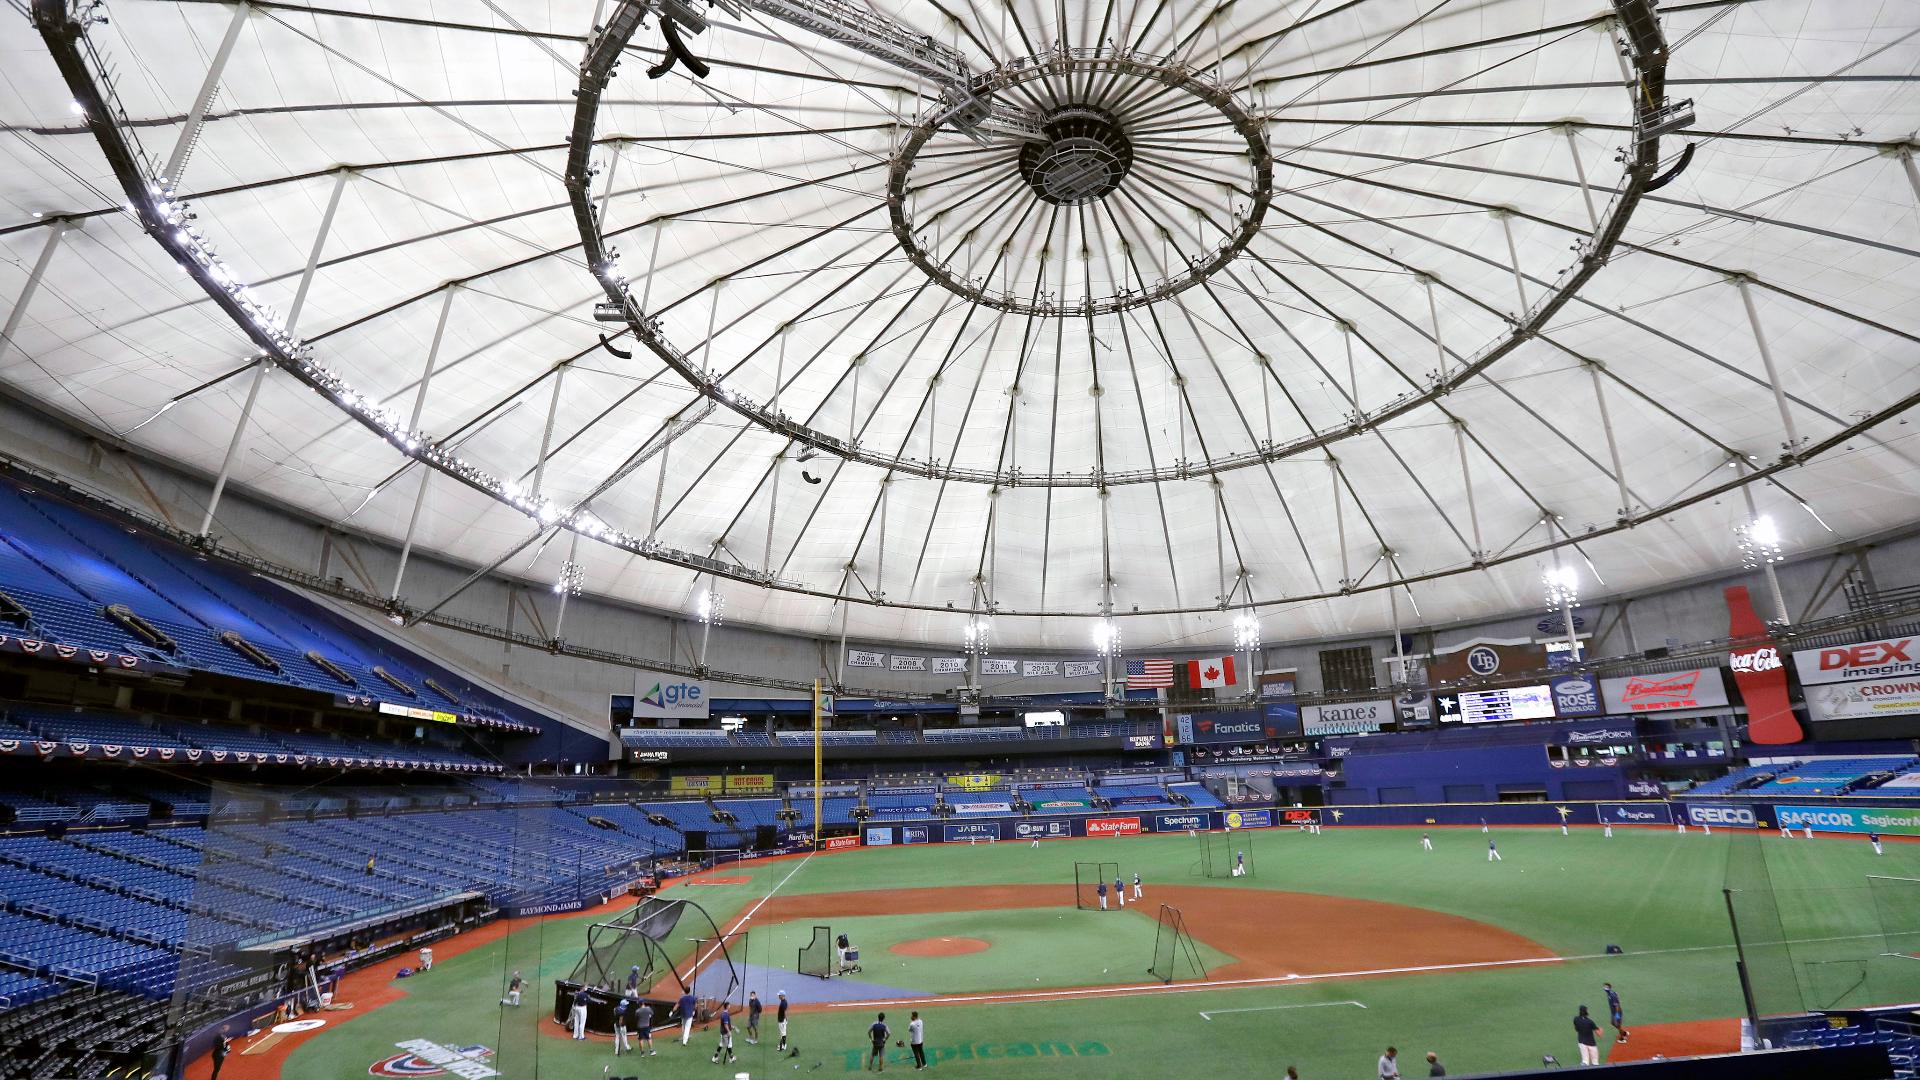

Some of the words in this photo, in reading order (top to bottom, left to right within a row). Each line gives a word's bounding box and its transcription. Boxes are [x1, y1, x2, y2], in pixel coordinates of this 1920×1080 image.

[1473, 652, 1495, 670] TB
[1729, 649, 1783, 673] Coca-Cola
[1820, 640, 1912, 670] DEX
[665, 682, 700, 704] gte
[1860, 682, 1920, 697] CROWN
[1557, 693, 1596, 707] ROSE
[1560, 704, 1597, 713] RADIOLOGY
[1180, 716, 1190, 724] 42
[1214, 722, 1260, 734] Fanatics
[1629, 785, 1644, 793] Hard
[1645, 784, 1659, 795] Rock
[1164, 817, 1199, 825] Spectrum
[1285, 811, 1312, 820] DEX
[1691, 808, 1752, 823] GEICO
[1780, 812, 1855, 826] SAGICOR
[1100, 823, 1119, 831] State
[1120, 822, 1138, 830] Farm
[520, 904, 558, 915] RAYMOND
[560, 901, 582, 910] JAMES
[836, 1039, 1113, 1073] Topicana
